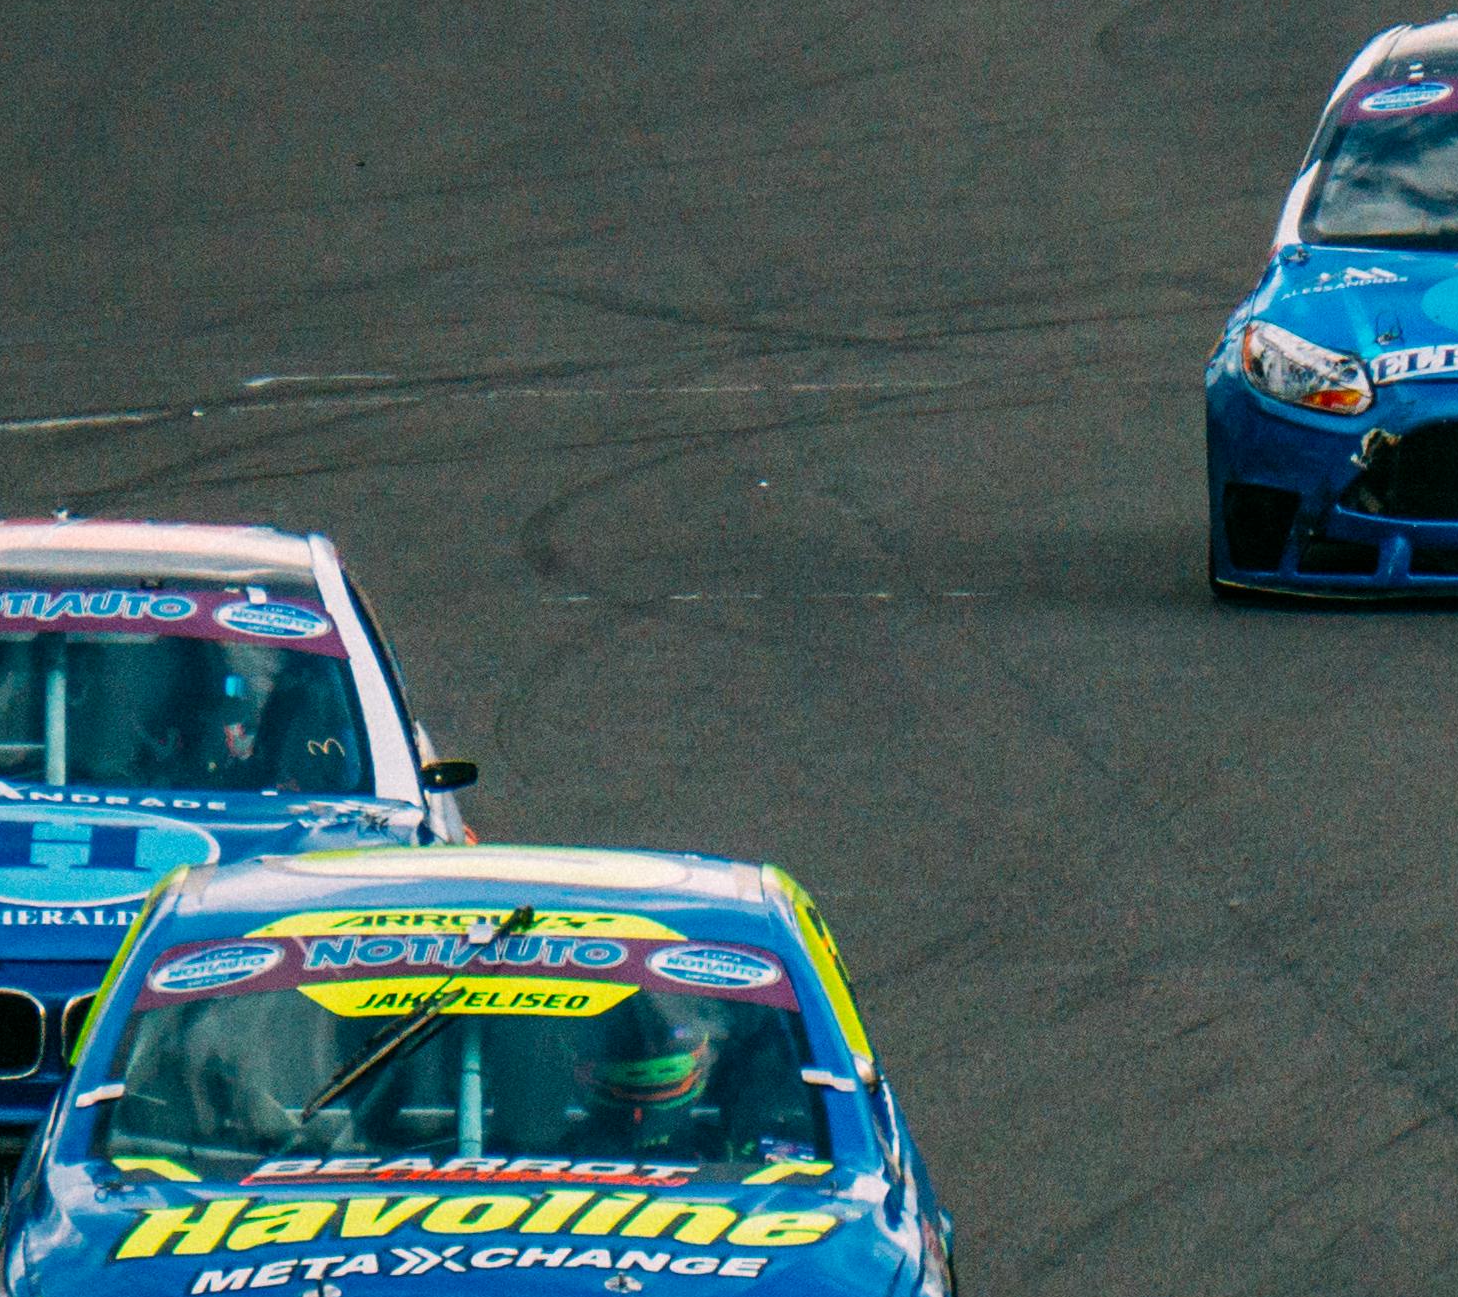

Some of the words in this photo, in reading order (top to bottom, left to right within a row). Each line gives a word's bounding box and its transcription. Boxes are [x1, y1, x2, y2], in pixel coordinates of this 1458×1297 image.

[304, 935, 629, 969] NOTIAUTO
[252, 1157, 700, 1179] BEARROT
[115, 1190, 841, 1261] Havoline
